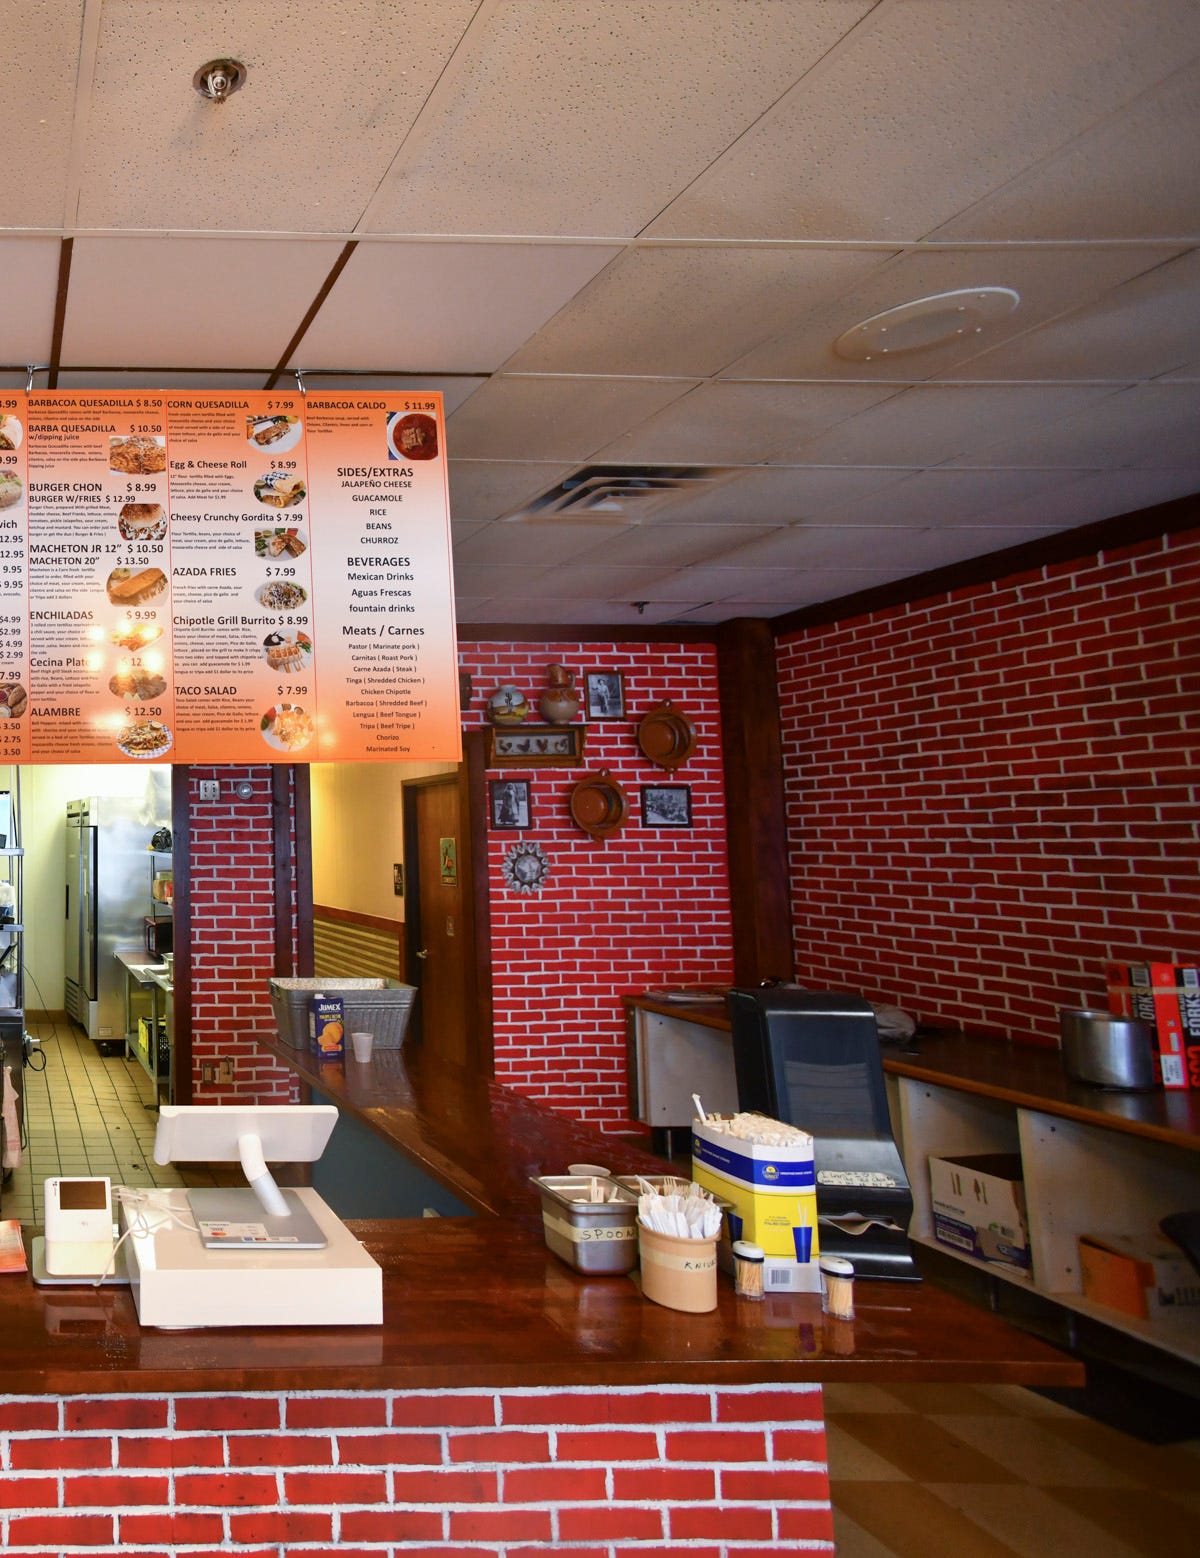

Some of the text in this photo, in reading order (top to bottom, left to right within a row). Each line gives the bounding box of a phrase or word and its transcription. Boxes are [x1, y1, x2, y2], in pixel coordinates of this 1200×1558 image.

[79, 399, 134, 408] QUESADILLA
[306, 401, 386, 410] BARBACOA CALDO
[170, 460, 185, 470] Egg
[196, 460, 228, 468] Cheese
[230, 460, 247, 468] Roll
[337, 467, 414, 478] SIDES/EXTRAS
[341, 479, 382, 488] JALAPEÑO
[171, 513, 202, 523] Cheesy
[204, 513, 240, 523] Crunchy
[241, 513, 274, 522] Gordita
[347, 557, 410, 566] BEVERAGES
[172, 568, 236, 576] AZADA FRIES
[348, 572, 414, 580] Mexican Drinks
[352, 588, 412, 598] Aguas Frescas
[349, 604, 415, 612] fountain drinks
[31, 611, 93, 620] ENCHILADAS
[174, 616, 214, 627] Chipotle
[217, 616, 238, 625] Grill
[241, 616, 276, 625] Burrito
[342, 626, 376, 636] Meats
[388, 626, 424, 636] Carnes
[30, 658, 63, 667] Cecina
[176, 686, 237, 695] TACO SALAD
[30, 708, 80, 716] ALAMBRE
[319, 1003, 341, 1011] JUMEX
